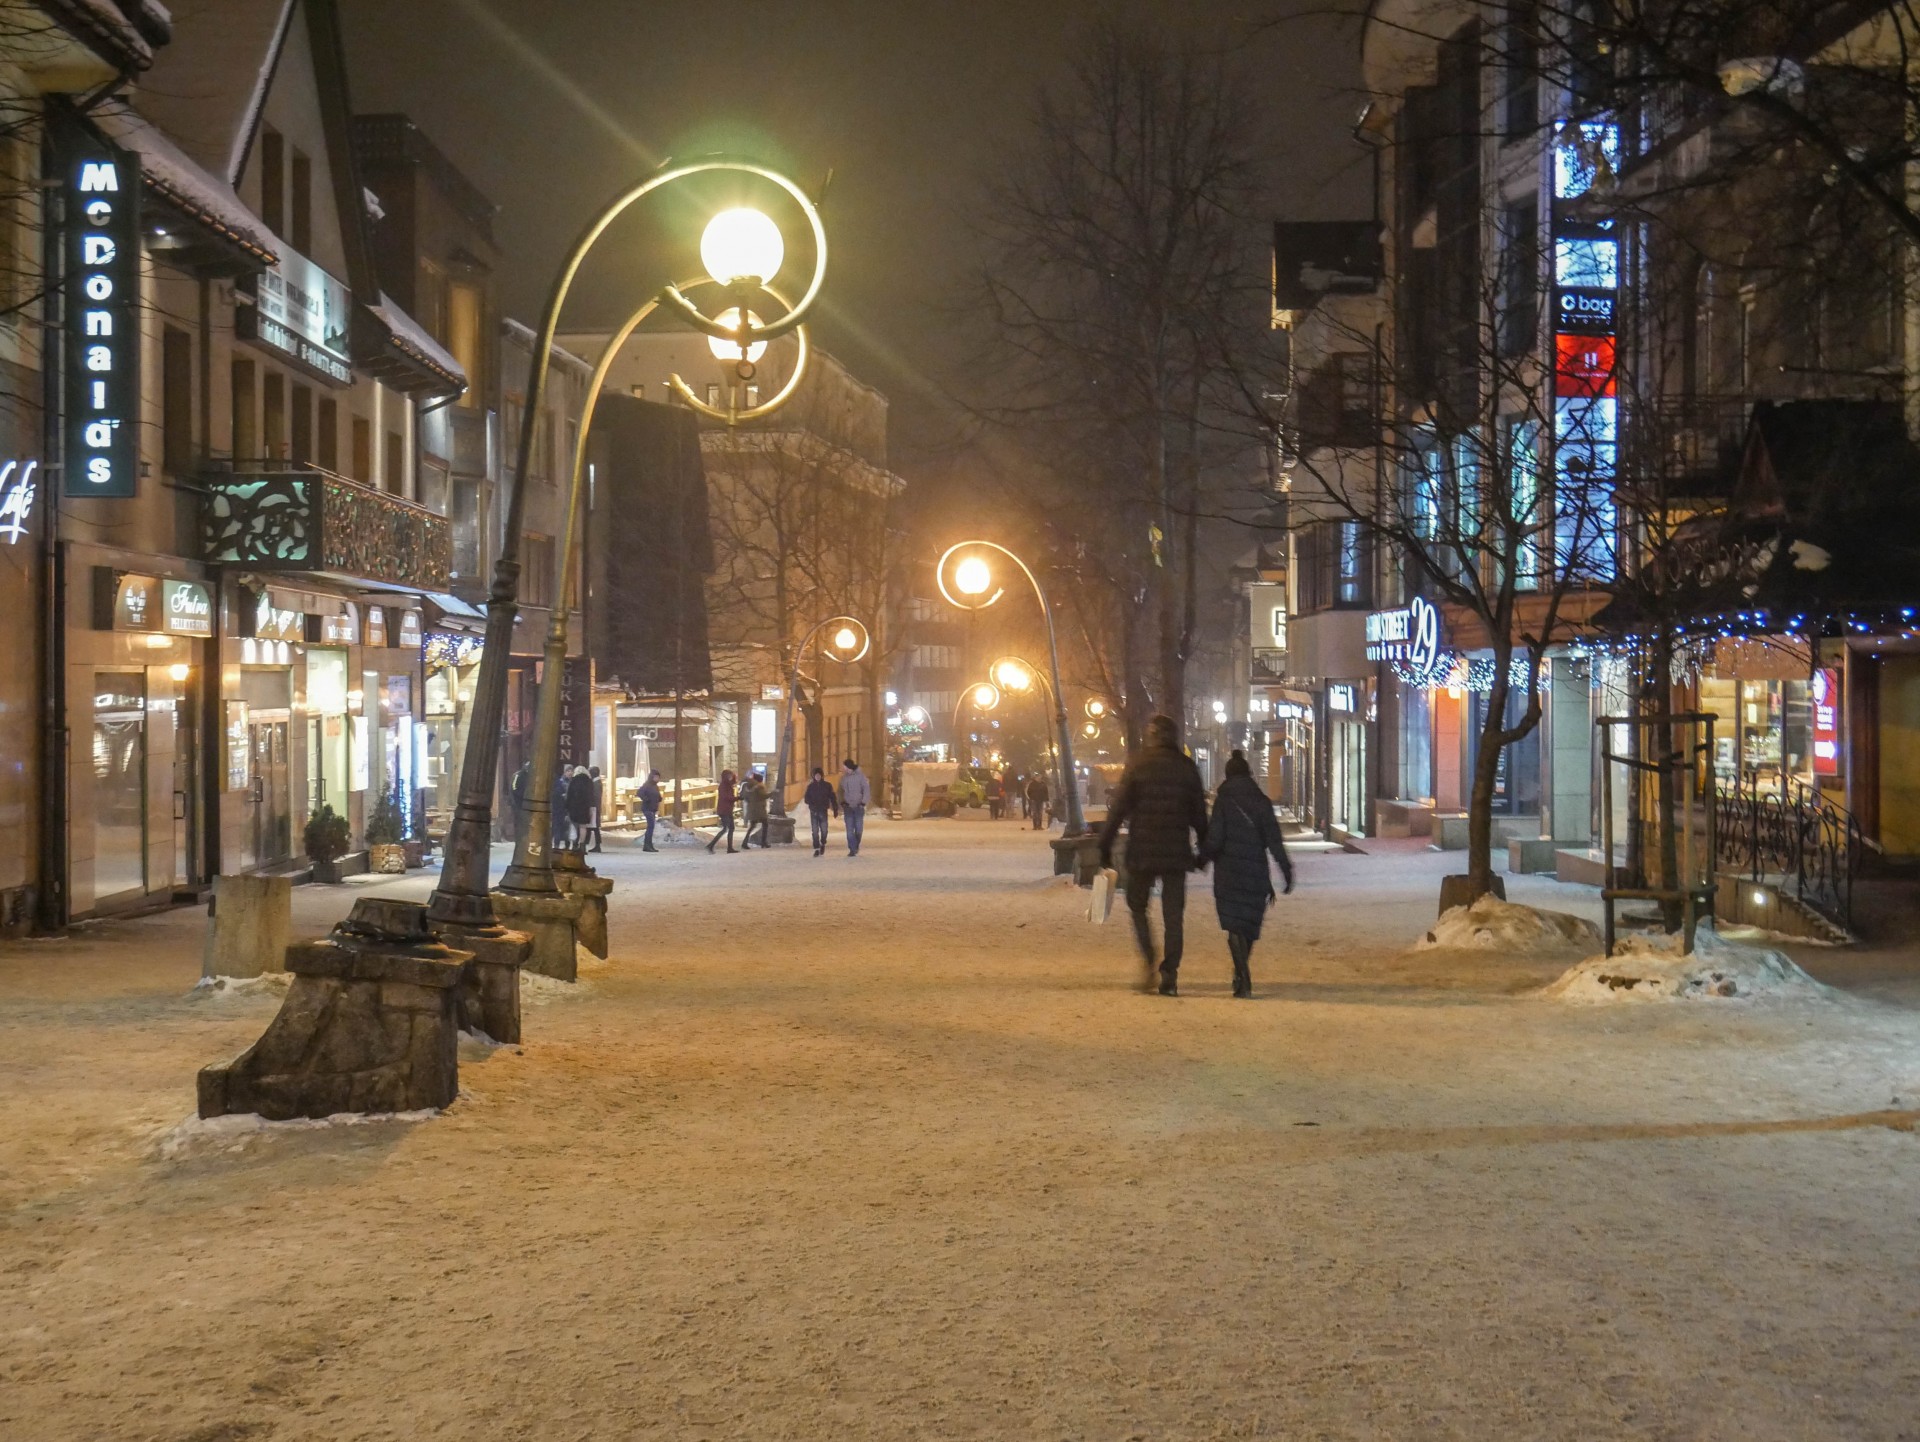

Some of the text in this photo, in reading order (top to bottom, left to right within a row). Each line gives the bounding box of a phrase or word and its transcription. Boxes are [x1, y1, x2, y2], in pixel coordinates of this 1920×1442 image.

[1578, 295, 1612, 315] bag
[1411, 596, 1438, 675] 29
[560, 661, 573, 765] CUKIERN
